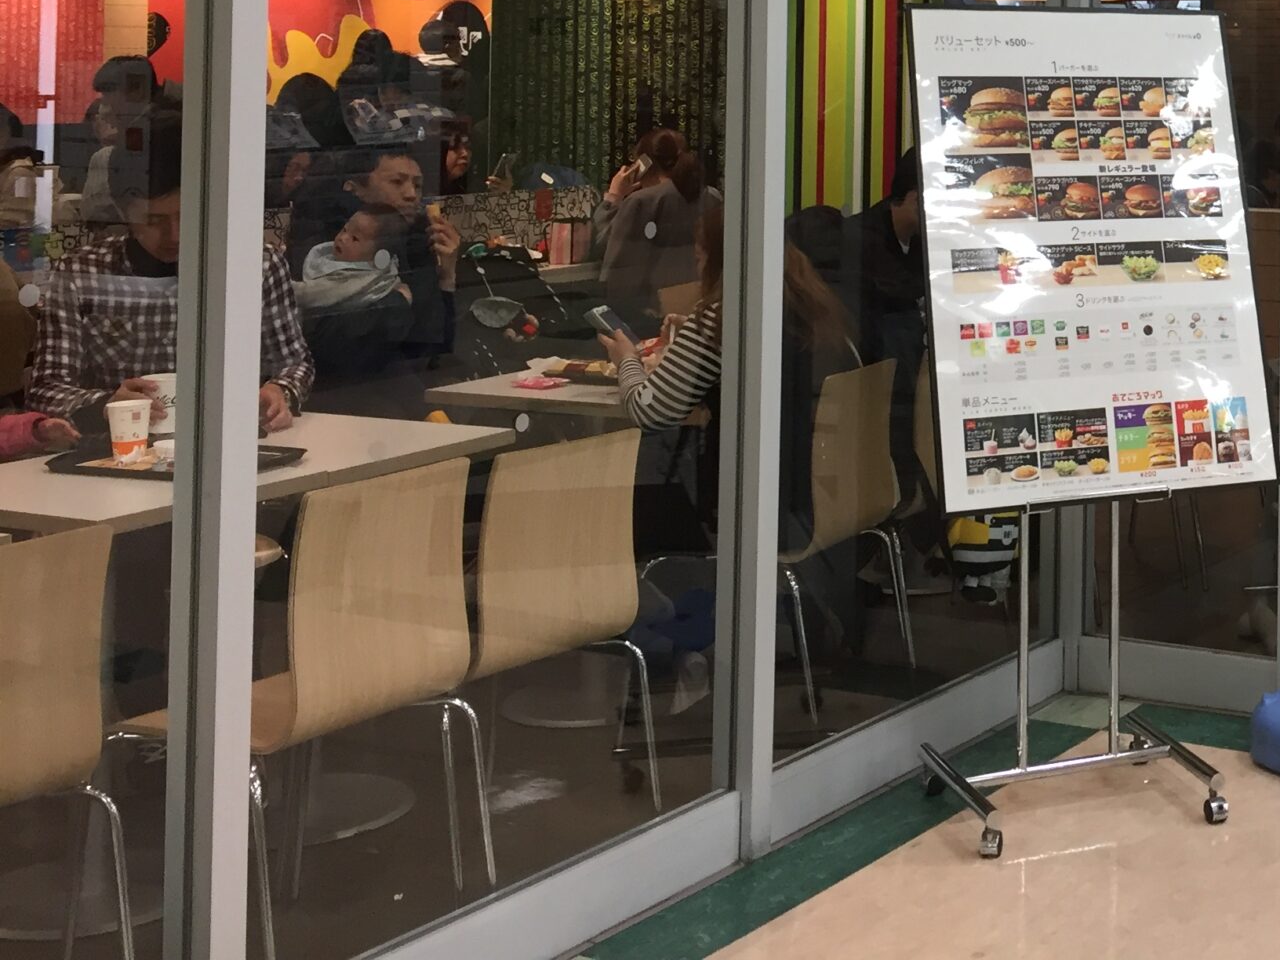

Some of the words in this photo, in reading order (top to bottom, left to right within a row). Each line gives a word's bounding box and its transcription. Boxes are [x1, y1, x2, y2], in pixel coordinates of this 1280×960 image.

[934, 34, 1002, 47] バリューセット
[940, 79, 973, 88] ビッグマック
[1071, 226, 1079, 241] 2
[1075, 293, 1085, 308] 3
